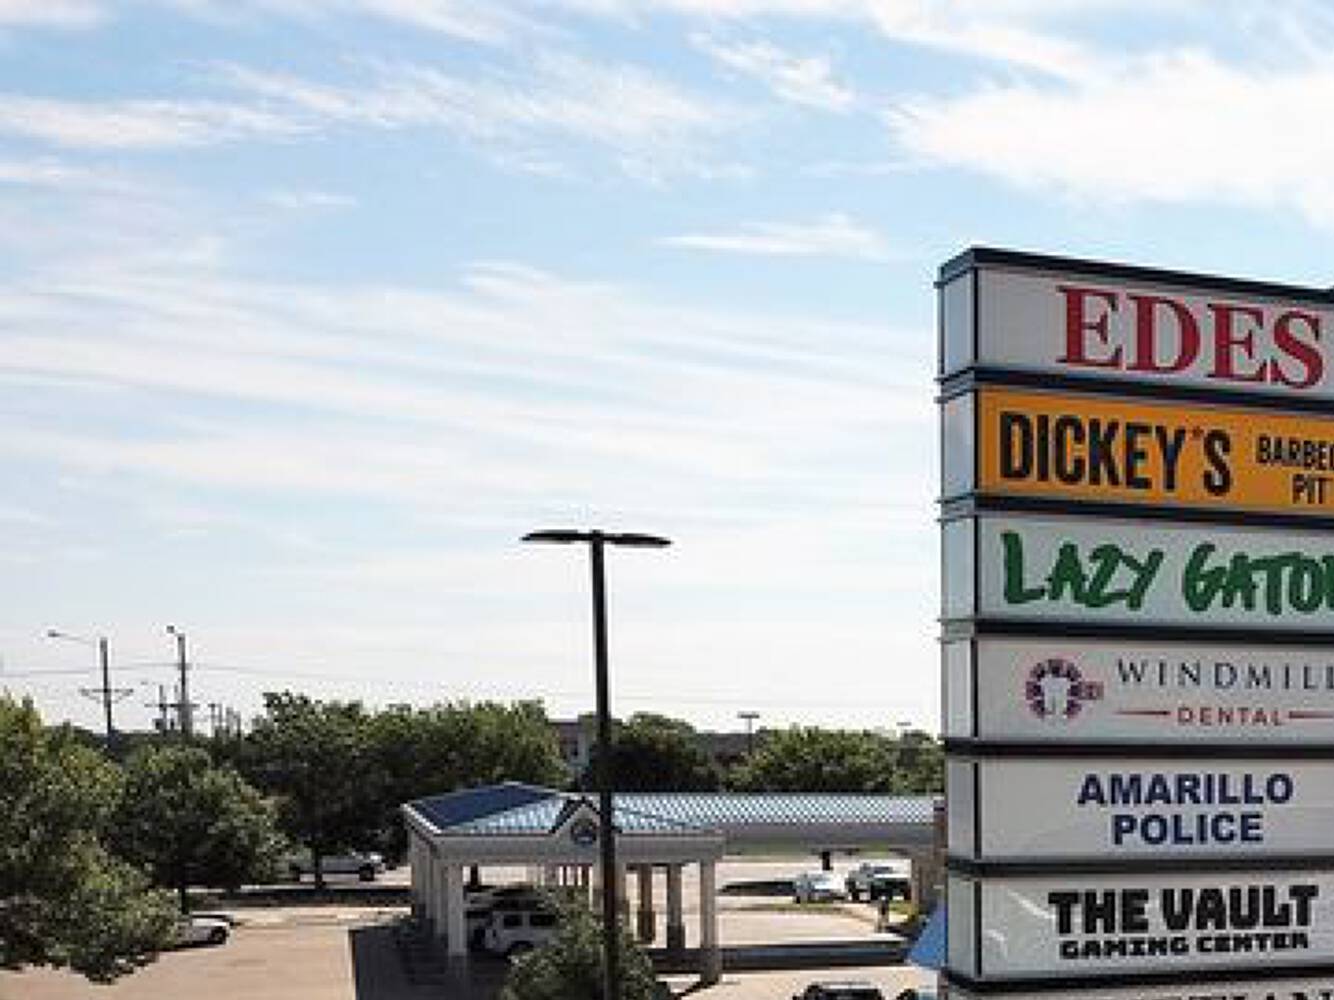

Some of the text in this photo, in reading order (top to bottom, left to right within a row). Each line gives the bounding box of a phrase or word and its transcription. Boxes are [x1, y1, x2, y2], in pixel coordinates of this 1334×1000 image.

[1056, 285, 1325, 389] EDES
[1000, 411, 1232, 496] DICKEY'S
[1292, 475, 1332, 504] PIT
[1001, 531, 1164, 610] LAZY
[1177, 706, 1286, 727] DENTAL
[1077, 773, 1294, 805] AMARILLO
[1113, 812, 1264, 845] POLICE
[1048, 885, 1319, 934] THE VAULT
[1059, 932, 1309, 960] GAMING CENTER
